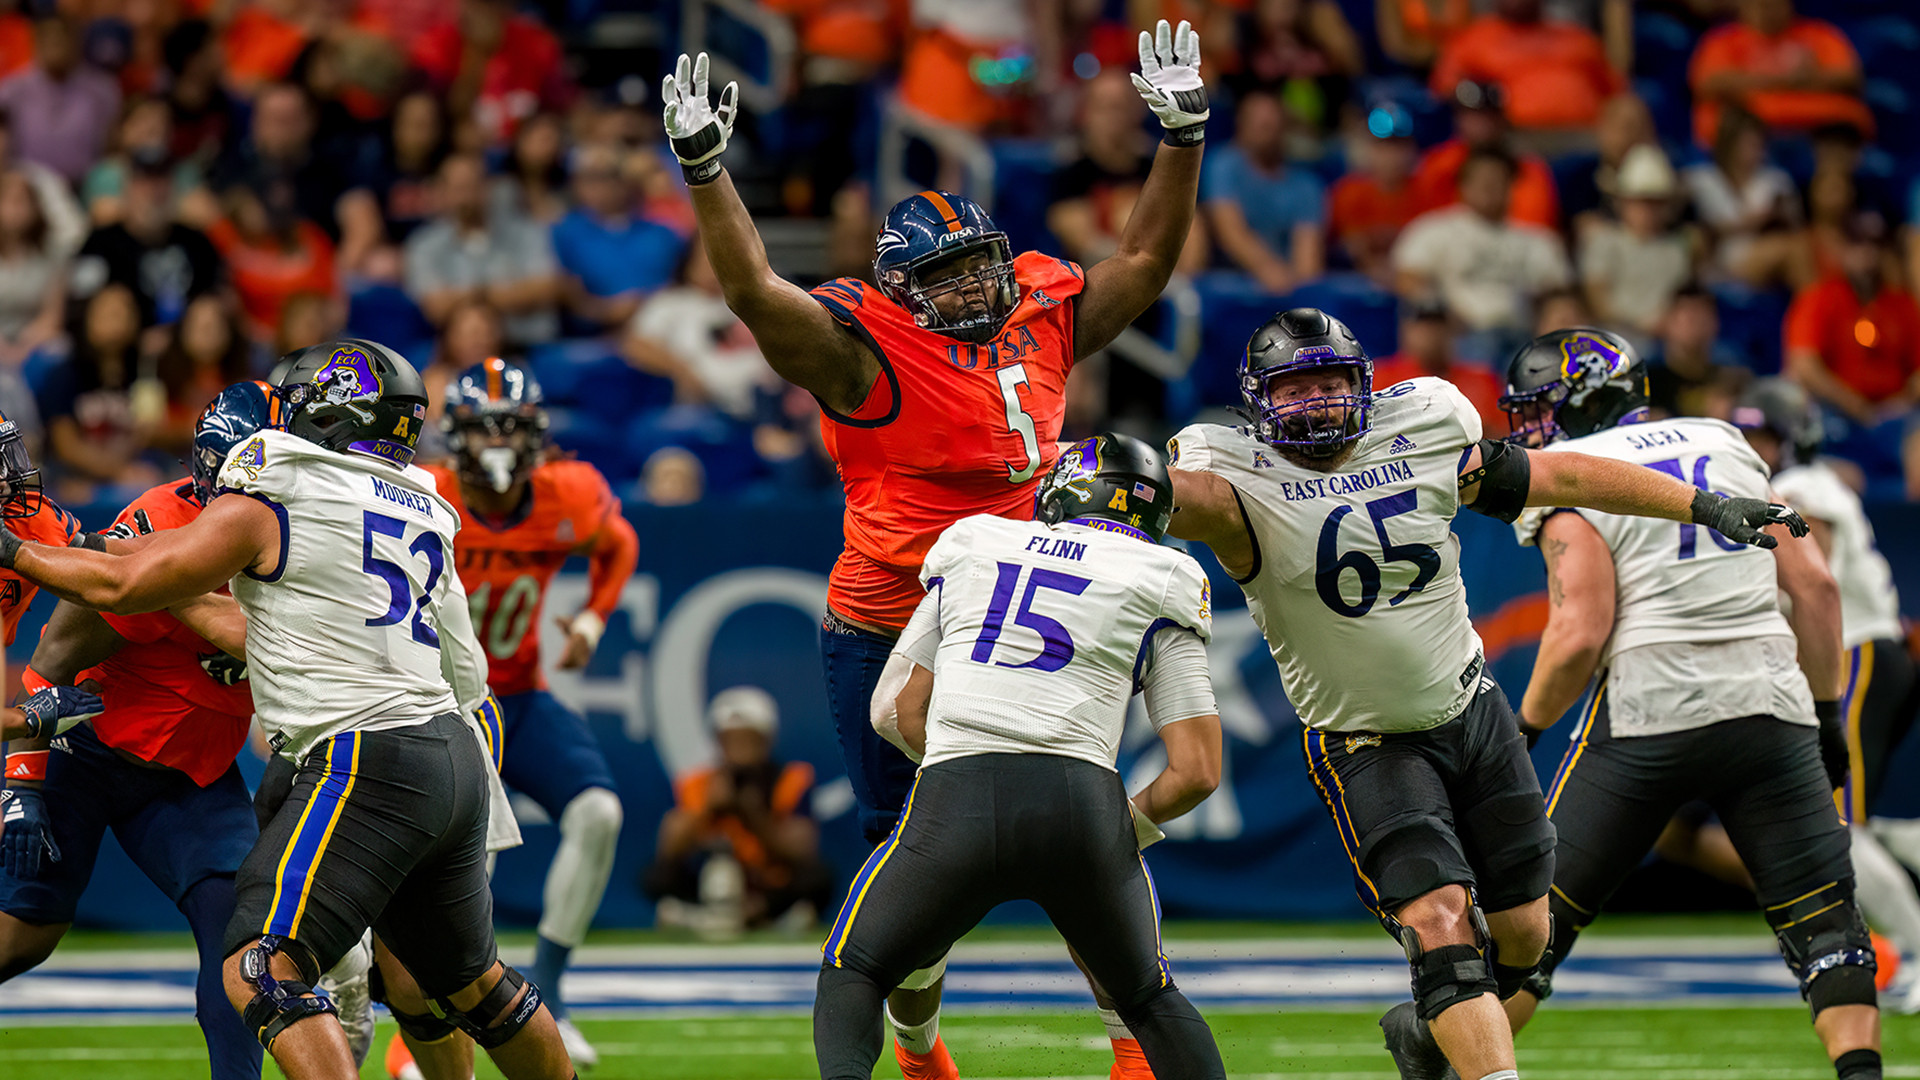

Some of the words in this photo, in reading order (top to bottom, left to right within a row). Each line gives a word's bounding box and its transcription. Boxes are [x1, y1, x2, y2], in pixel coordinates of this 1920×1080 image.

[945, 228, 973, 242] UTSA
[334, 355, 361, 366] ECU
[943, 325, 1041, 370] UTSA
[1299, 347, 1331, 355] PIRATES
[995, 361, 1042, 484] 5
[372, 443, 392, 455] NO
[1389, 441, 1417, 455] adidas
[371, 476, 434, 520] MOORER
[1280, 478, 1326, 501] EAST
[1329, 460, 1415, 495] CAROLINA
[1025, 535, 1088, 561] FLINN
[1315, 487, 1442, 618] 65
[363, 510, 445, 650] 52
[971, 560, 1093, 673] 15
